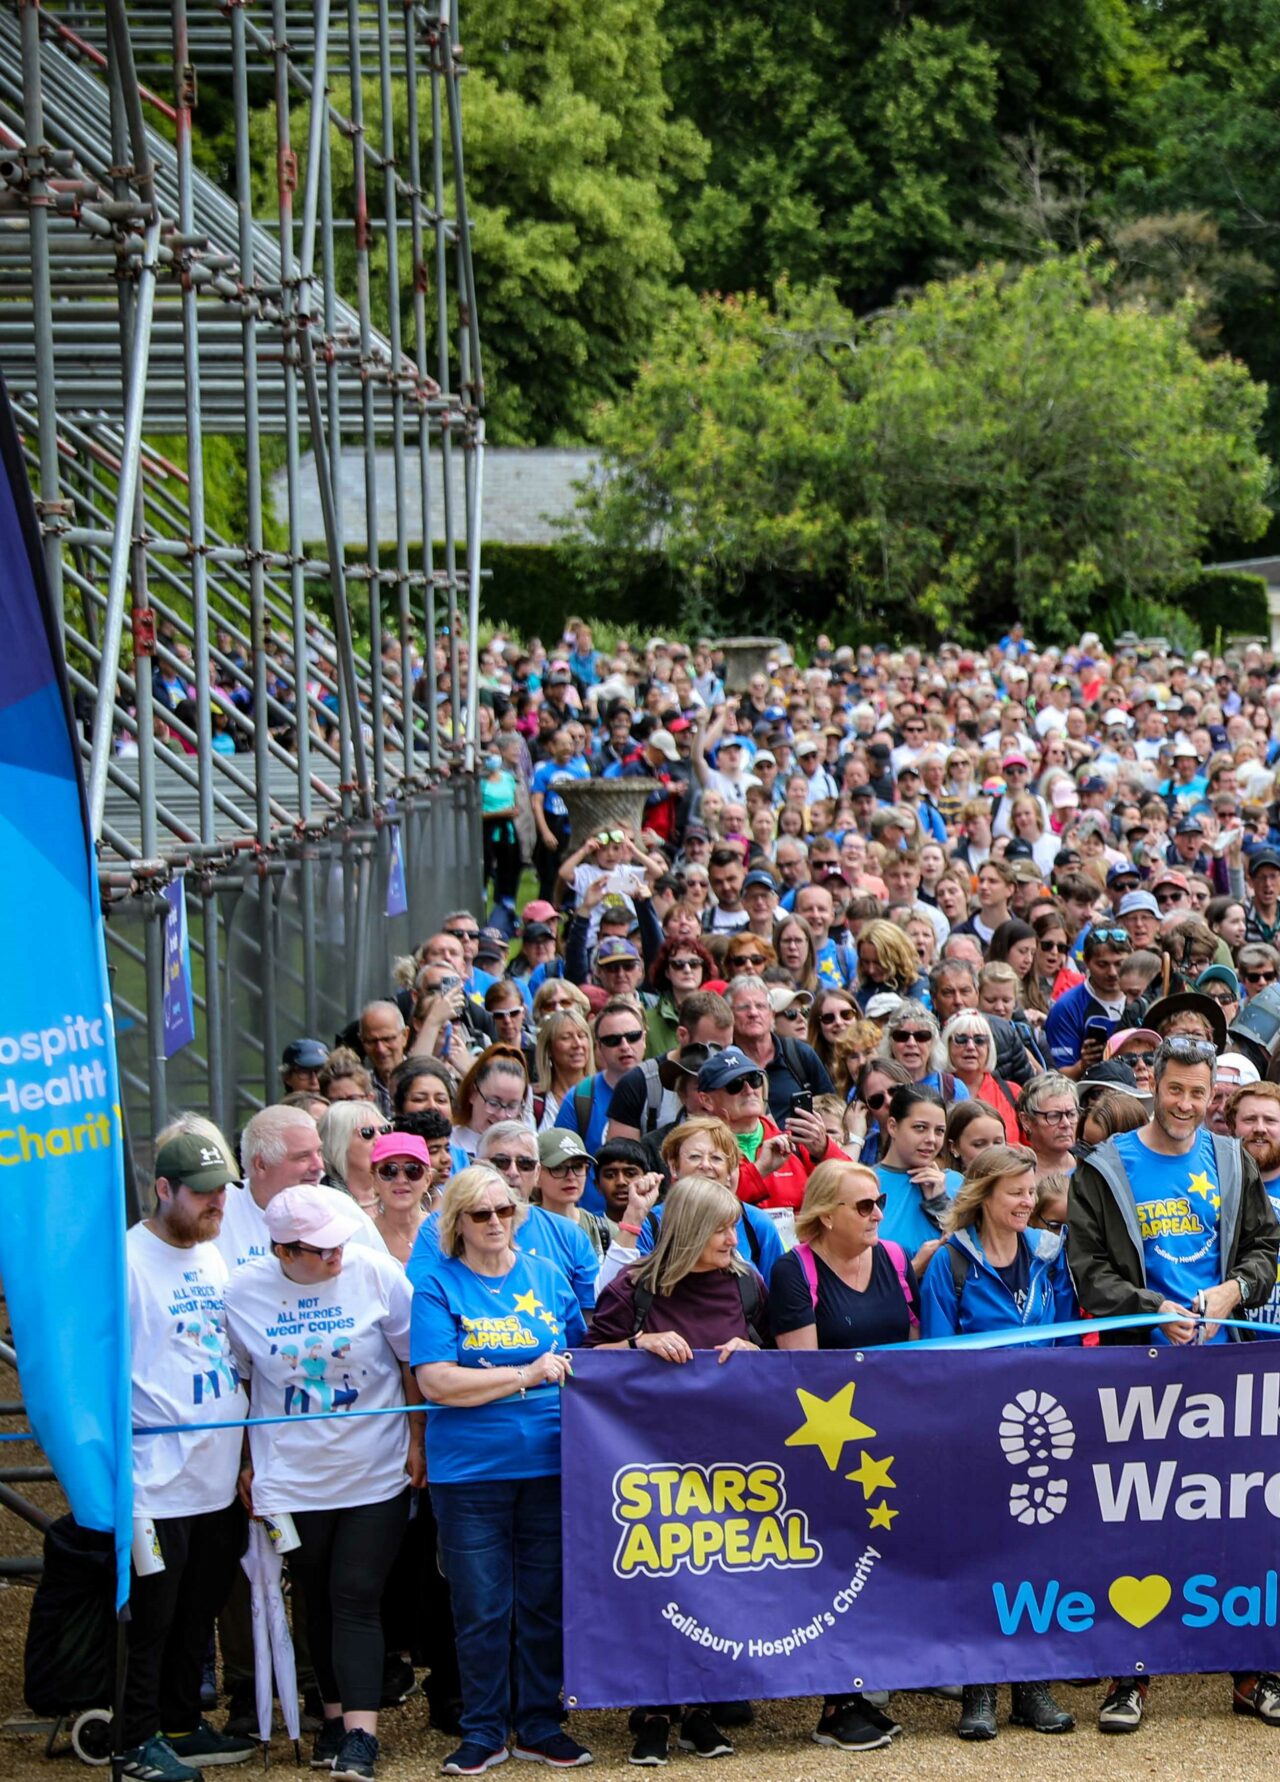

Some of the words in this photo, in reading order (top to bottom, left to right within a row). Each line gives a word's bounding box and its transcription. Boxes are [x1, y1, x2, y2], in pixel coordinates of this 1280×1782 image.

[1136, 1199, 1190, 1221] STARS
[1140, 1216, 1202, 1238] APPEAL
[183, 1271, 198, 1283] NOT
[173, 1287, 189, 1300] ALL
[297, 1297, 320, 1310] NOT
[168, 1301, 199, 1317] wear
[277, 1311, 294, 1325] ALL
[299, 1306, 343, 1320] HEROES
[266, 1321, 304, 1338] wear
[308, 1316, 356, 1334] capes
[462, 1317, 520, 1332] STARS
[464, 1330, 538, 1349] APPEAL
[619, 1468, 780, 1520] STARS
[620, 1516, 816, 1571] APPEAL
[661, 1601, 744, 1661] Salisbury
[748, 1611, 836, 1658] Hospital's
[832, 1544, 882, 1614] Charity
[992, 1579, 1095, 1636] We
